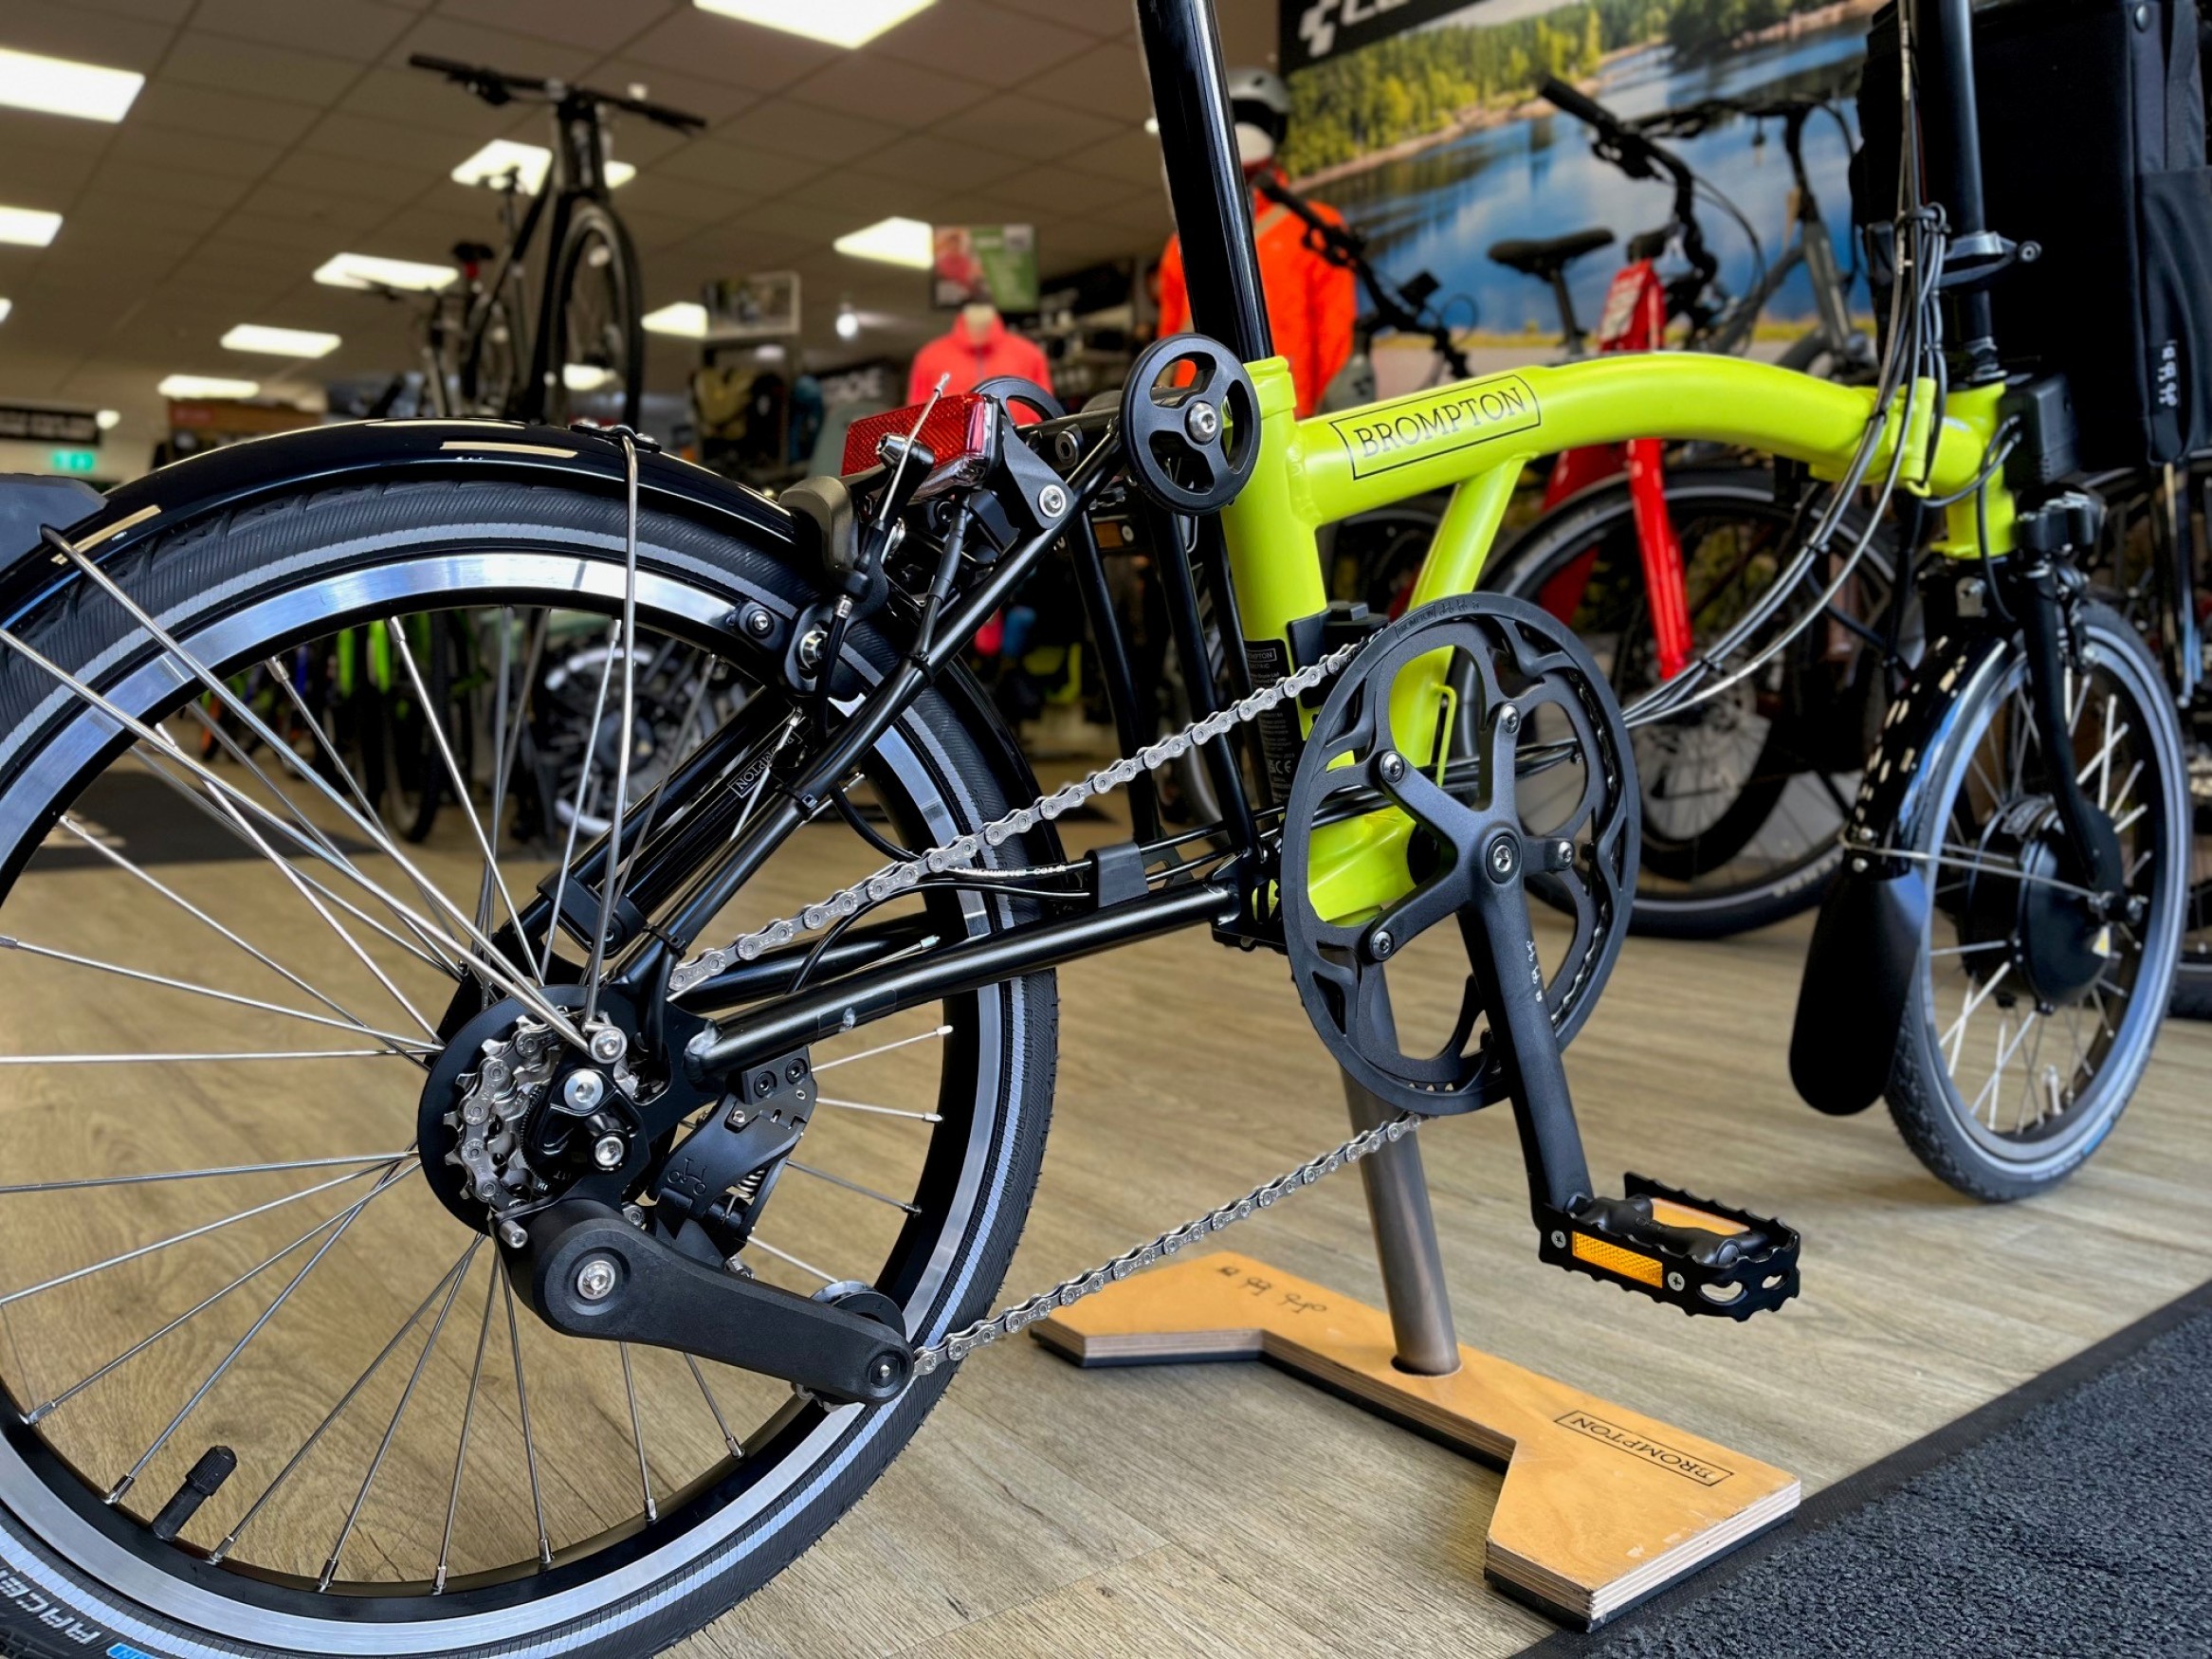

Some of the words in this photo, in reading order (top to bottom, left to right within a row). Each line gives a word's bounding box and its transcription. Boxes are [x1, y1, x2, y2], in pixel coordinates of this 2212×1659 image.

[1353, 387, 1526, 458] BROMPTON
[1570, 1417, 1714, 1479] BROMPTON
[0, 1569, 101, 1645] RACE
